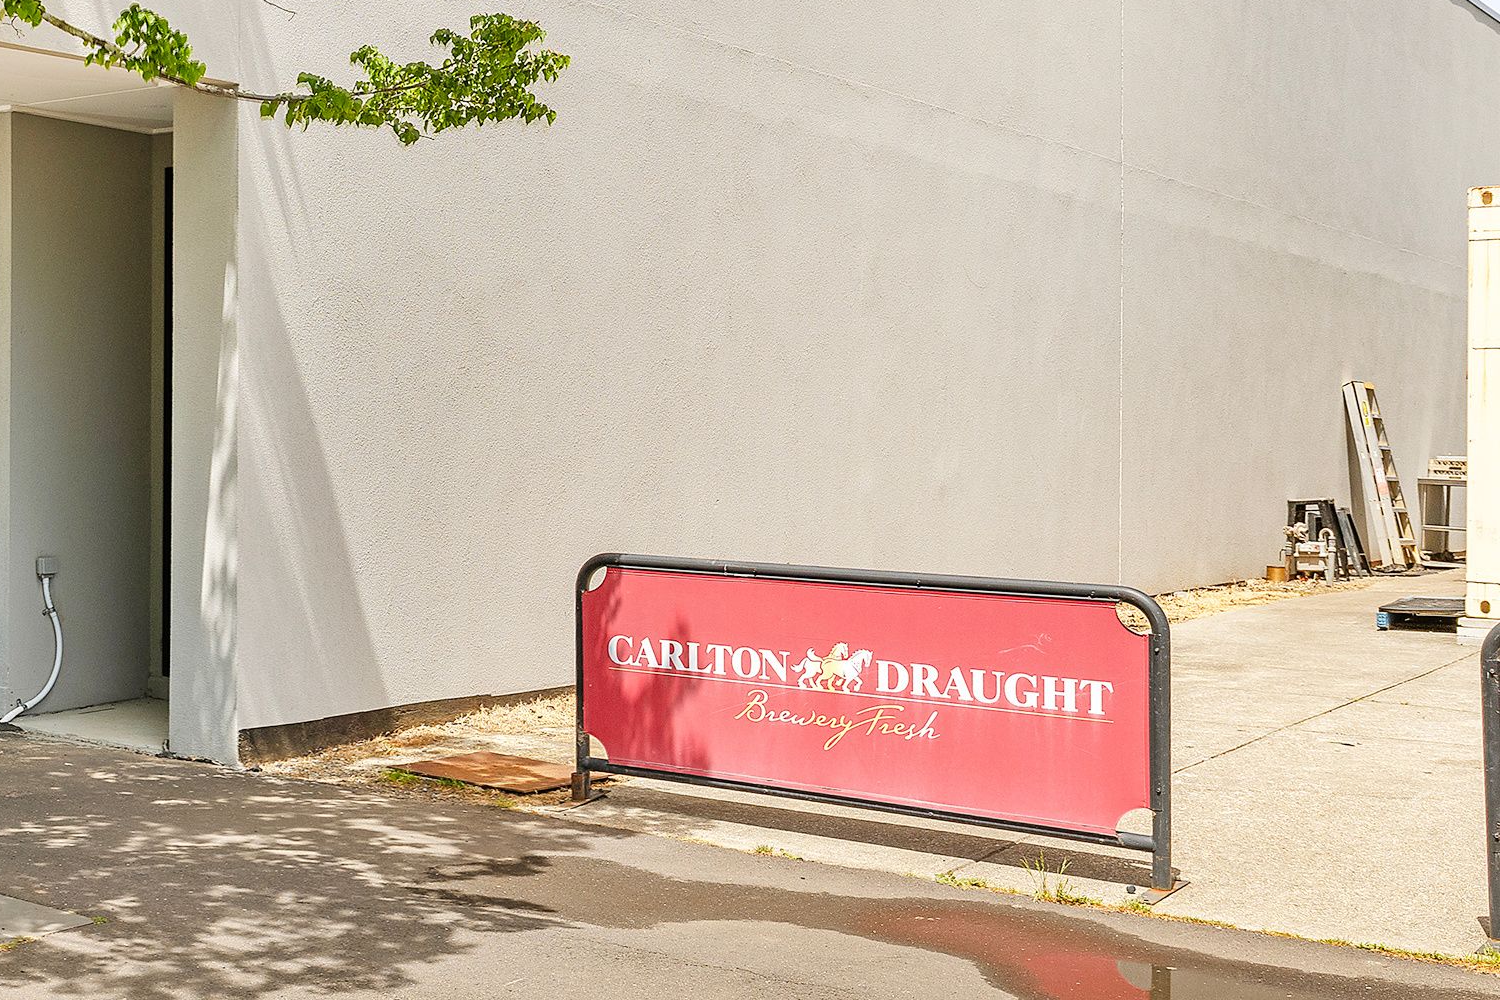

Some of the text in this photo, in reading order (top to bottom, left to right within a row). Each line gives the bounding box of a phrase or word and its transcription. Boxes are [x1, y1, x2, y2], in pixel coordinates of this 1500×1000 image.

[607, 634, 1115, 716] CARLTON DRAUGHT
[734, 689, 941, 751] Brewery Fresh
